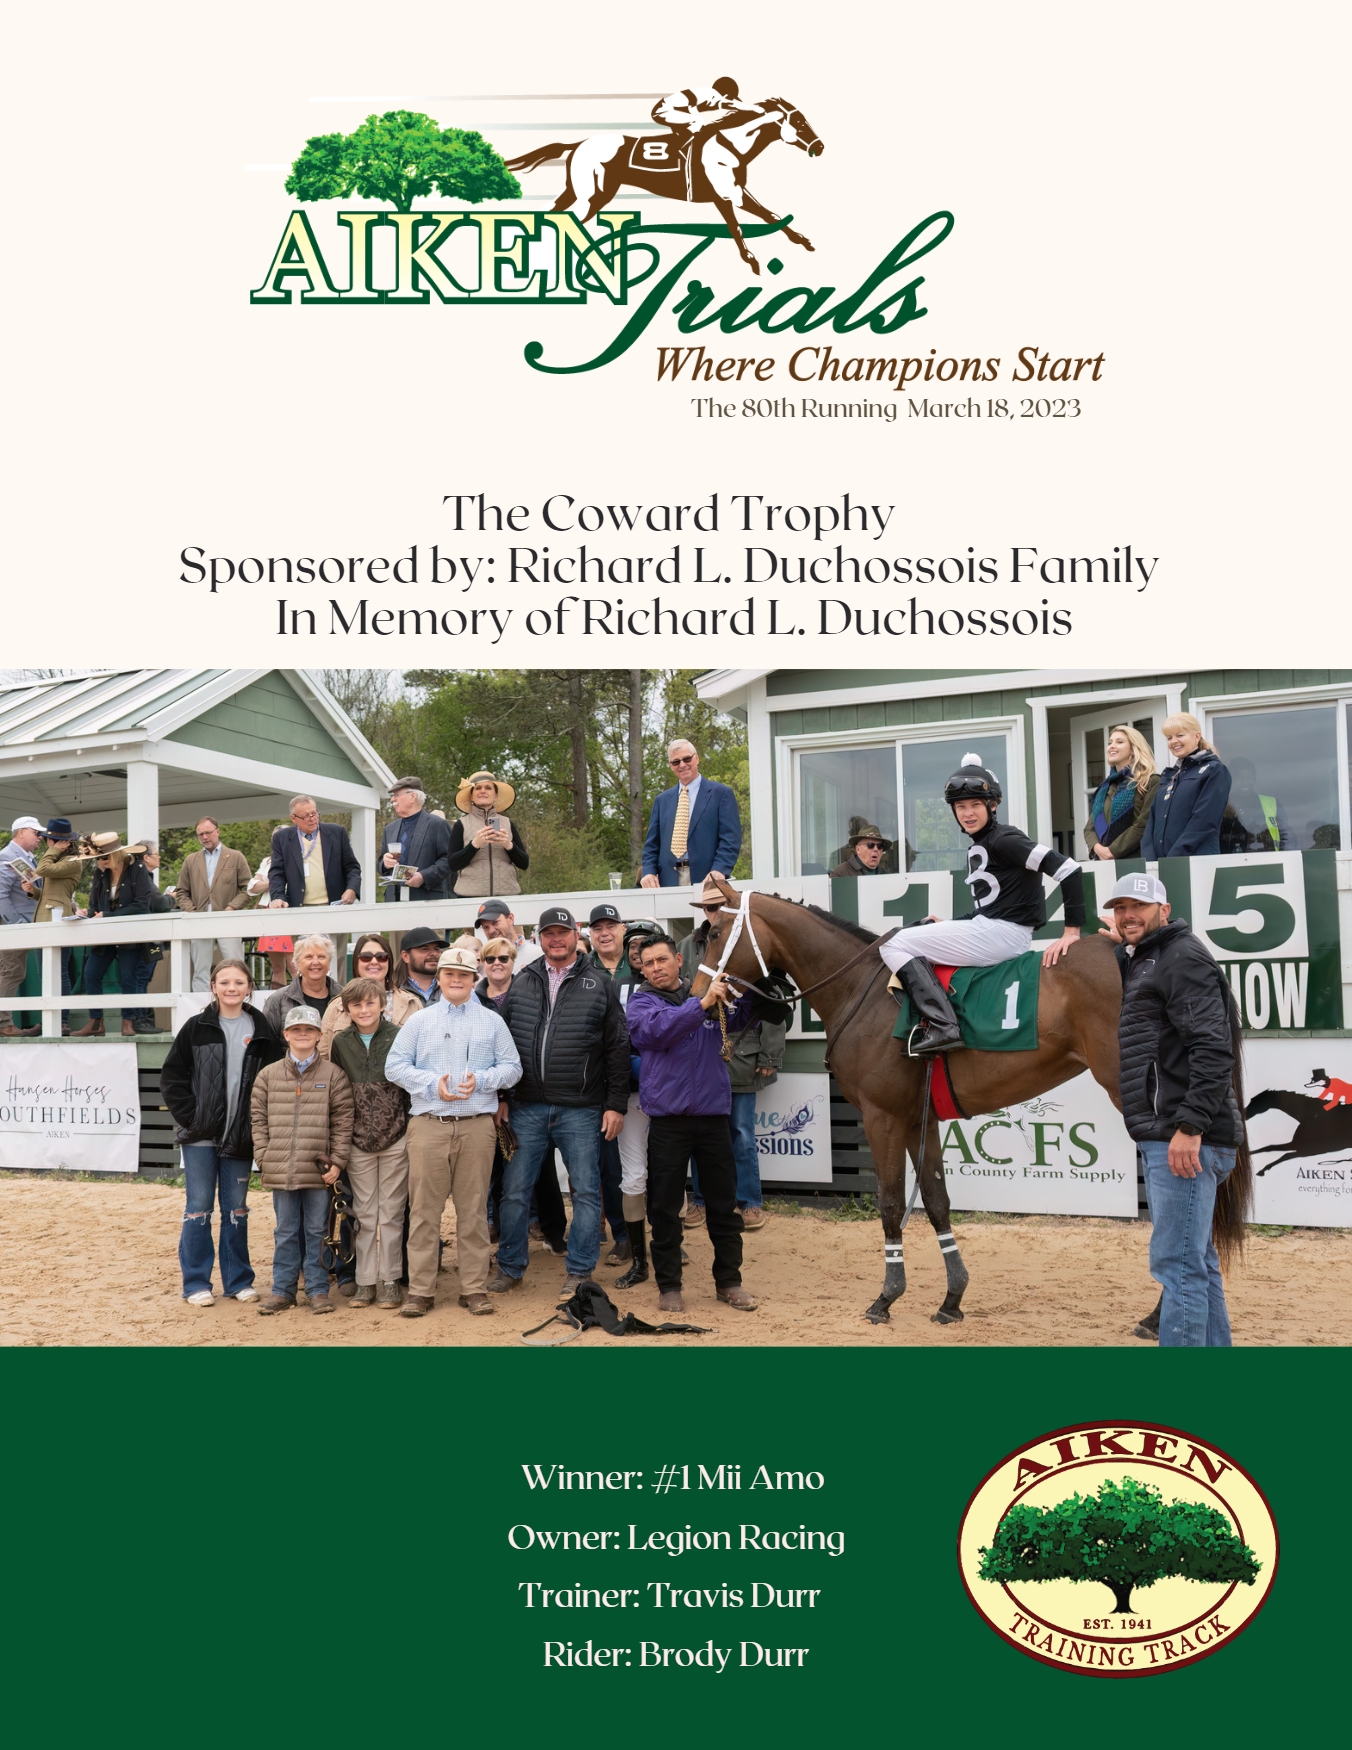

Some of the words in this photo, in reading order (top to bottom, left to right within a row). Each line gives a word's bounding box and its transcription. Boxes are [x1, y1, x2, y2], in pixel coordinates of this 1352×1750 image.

[1206, 863, 1296, 953] 5
[1001, 981, 1020, 1030] 1
[61, 1074, 111, 1103] Horses
[959, 1165, 1017, 1180] County
[1022, 1167, 1064, 1179] Farm
[1070, 1168, 1126, 1183] Supply
[1296, 1166, 1345, 1180] AIKEN
